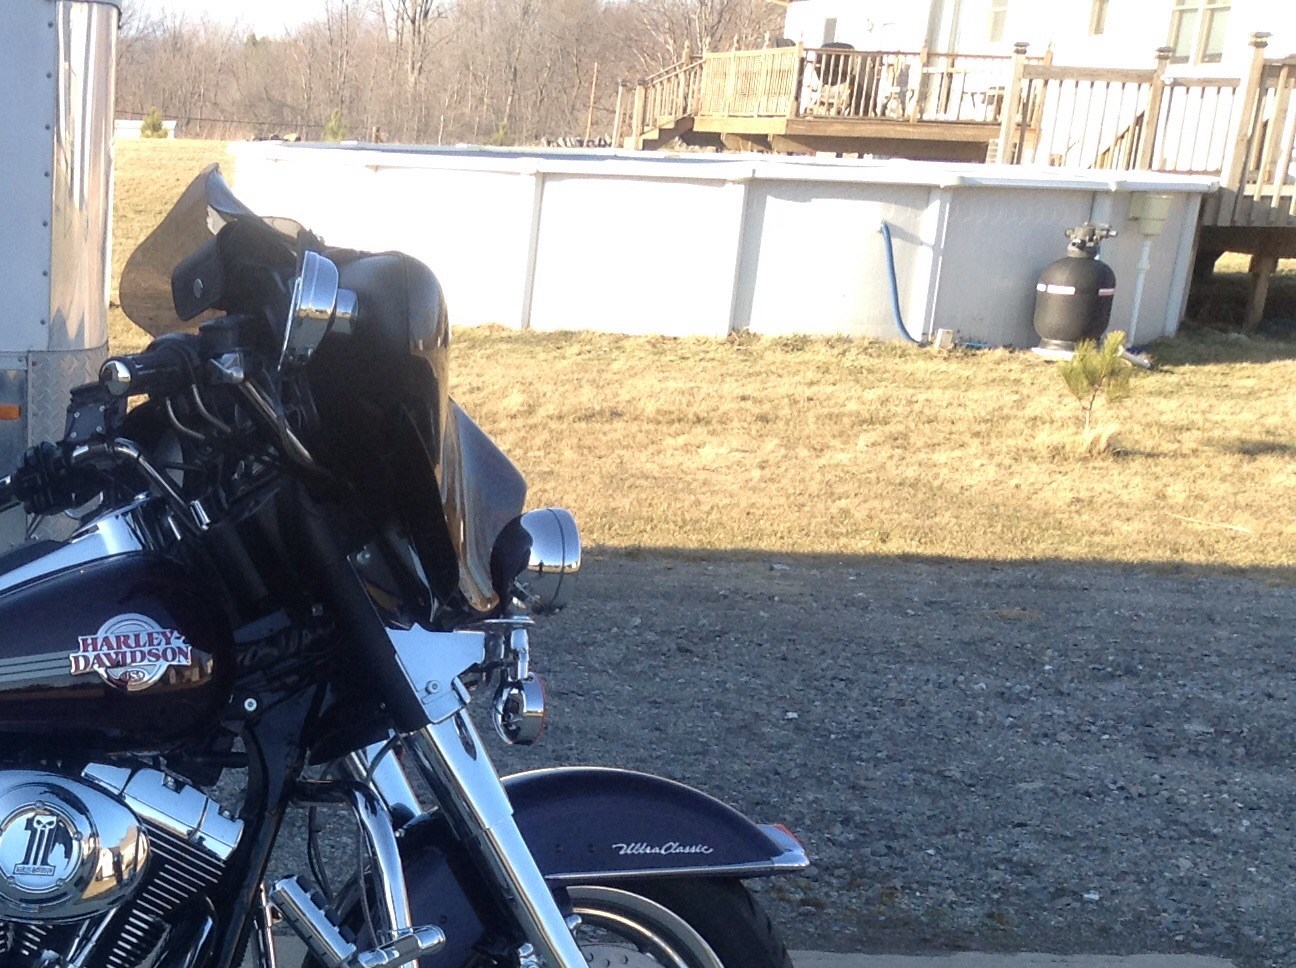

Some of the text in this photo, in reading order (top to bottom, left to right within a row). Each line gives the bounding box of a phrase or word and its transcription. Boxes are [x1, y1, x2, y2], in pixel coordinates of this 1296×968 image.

[70, 645, 192, 673] DAVIDSON
[612, 842, 714, 855] Ultra Classic
